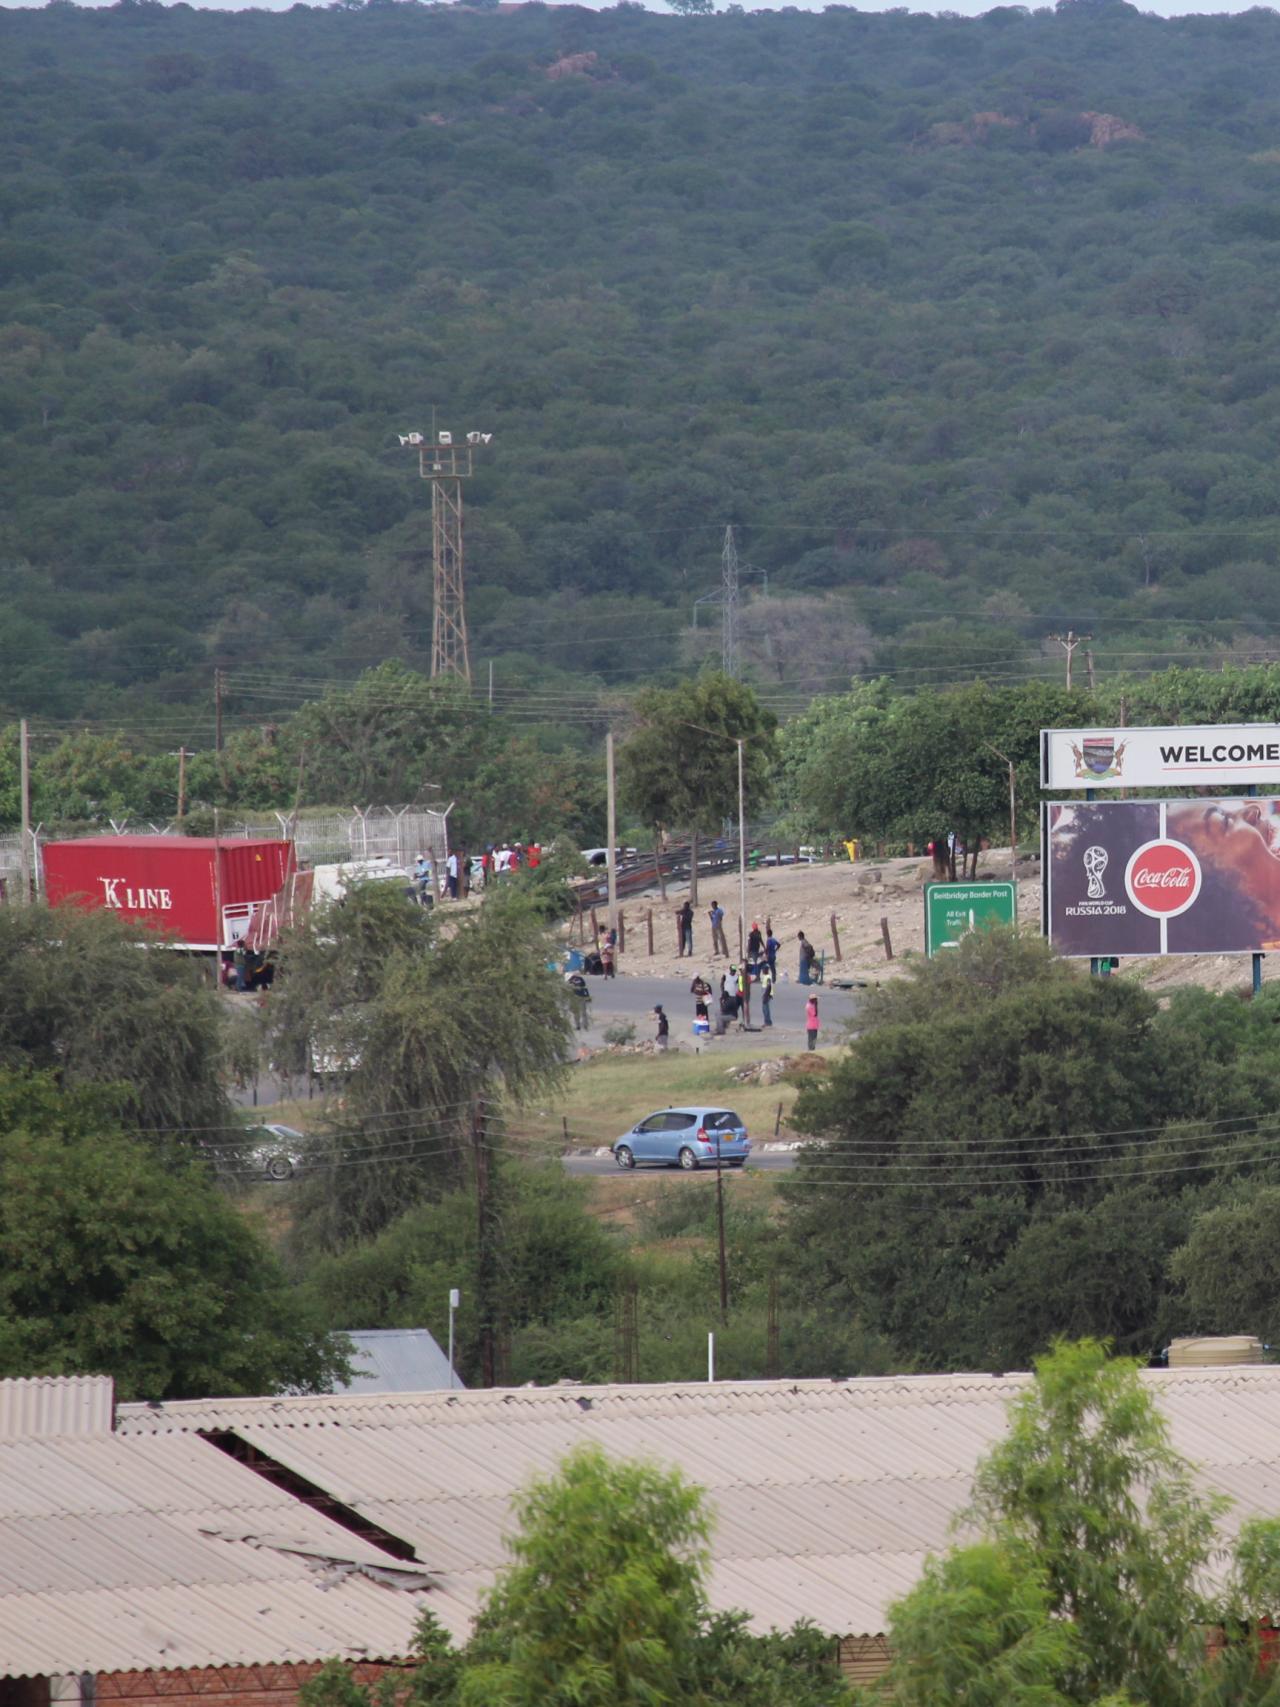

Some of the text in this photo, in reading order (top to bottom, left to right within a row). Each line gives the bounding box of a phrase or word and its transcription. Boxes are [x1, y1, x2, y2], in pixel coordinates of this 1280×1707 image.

[1159, 743, 1280, 763] WELCOME
[1134, 866, 1192, 888] Coca-Cola
[126, 888, 173, 909] LINE
[934, 892, 969, 900] Beitbridge
[969, 891, 992, 899] Border
[1065, 905, 1127, 916] RUSSIA 2018
